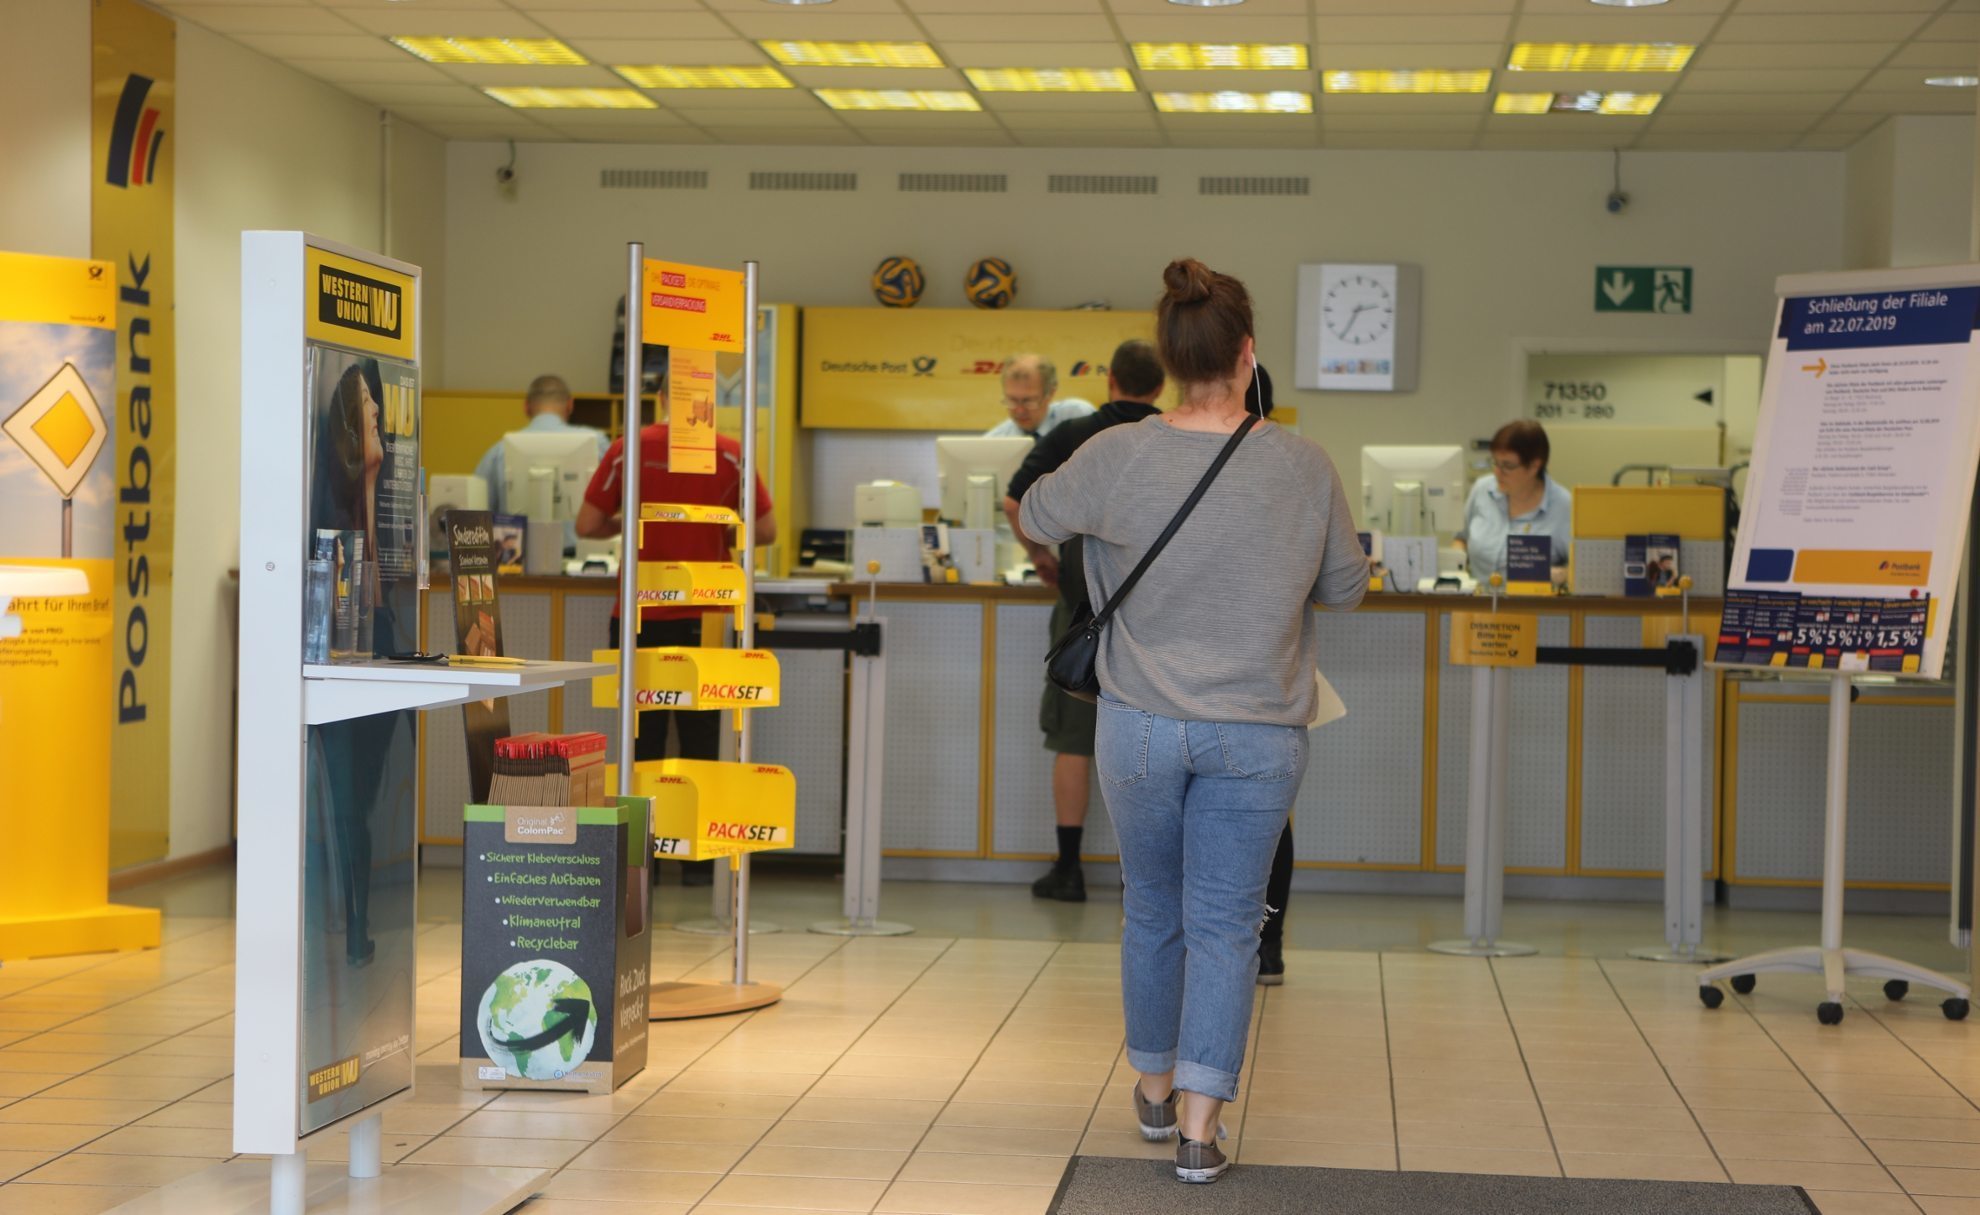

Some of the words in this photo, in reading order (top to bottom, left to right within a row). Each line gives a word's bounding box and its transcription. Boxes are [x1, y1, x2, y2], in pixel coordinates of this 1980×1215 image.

[322, 273, 369, 304] WESTERN
[1808, 296, 1878, 314] Schließung
[1882, 294, 1906, 310] der
[1909, 291, 1949, 308] Filiale
[337, 298, 368, 324] UNION
[1804, 320, 1824, 335] am
[1828, 315, 1897, 333] 22.07.2019
[821, 360, 879, 373] Deutsche
[881, 360, 907, 373] Post
[1544, 382, 1606, 400] 71350
[118, 250, 152, 725] Postbank
[637, 590, 680, 601] PACKSET
[692, 588, 734, 600] PACKSET
[44, 598, 63, 612] für
[1470, 622, 1521, 632] DISKRETION
[1477, 632, 1495, 640] Bitte
[1497, 632, 1512, 640] hier
[1481, 640, 1508, 649] warten
[636, 689, 682, 705] CKSET
[700, 684, 763, 701] PACKSET
[517, 816, 547, 826] Original
[517, 826, 564, 836] ColomPac
[707, 822, 778, 841] PACKSET
[486, 852, 525, 863] Sicherer
[527, 853, 600, 865] Klebeverschluss
[494, 872, 547, 885] Einfaches
[550, 873, 601, 886] Aufbauen
[502, 895, 600, 908] Wiederverwendbar
[509, 914, 581, 931] Klimaneutral
[517, 936, 579, 951] Recyclebar
[310, 1065, 340, 1087] WESTERN
[319, 1077, 340, 1096] UNION
